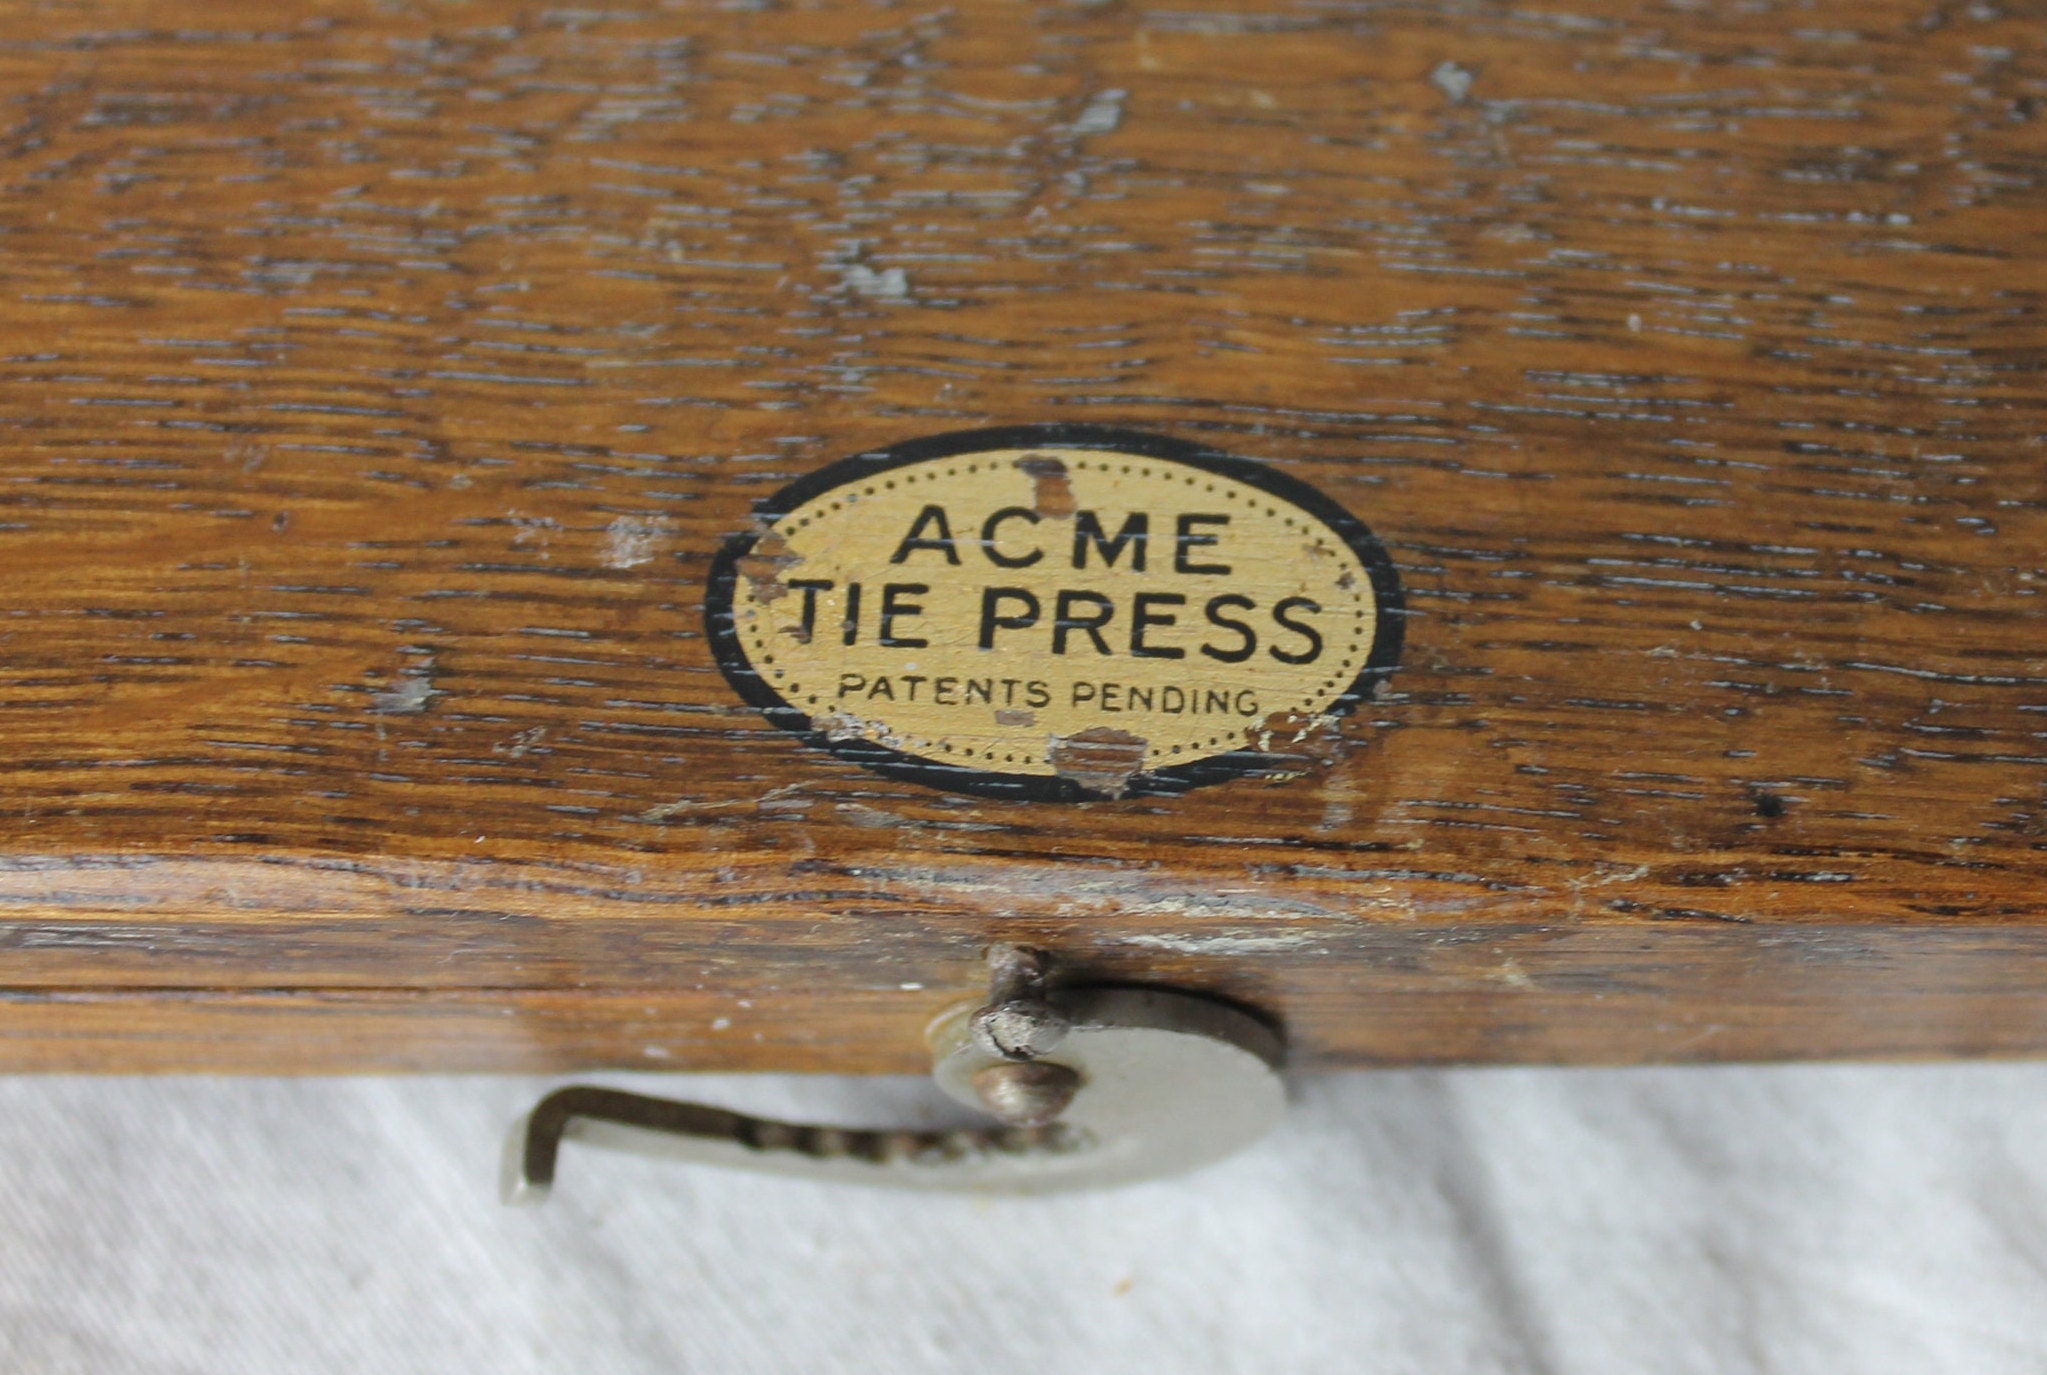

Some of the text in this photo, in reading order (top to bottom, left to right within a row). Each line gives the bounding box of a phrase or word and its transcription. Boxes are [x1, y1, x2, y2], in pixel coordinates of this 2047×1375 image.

[889, 504, 1232, 576] ACME
[788, 578, 1324, 666] TIE PRESS
[837, 673, 1259, 717] PATENTS PENDING
